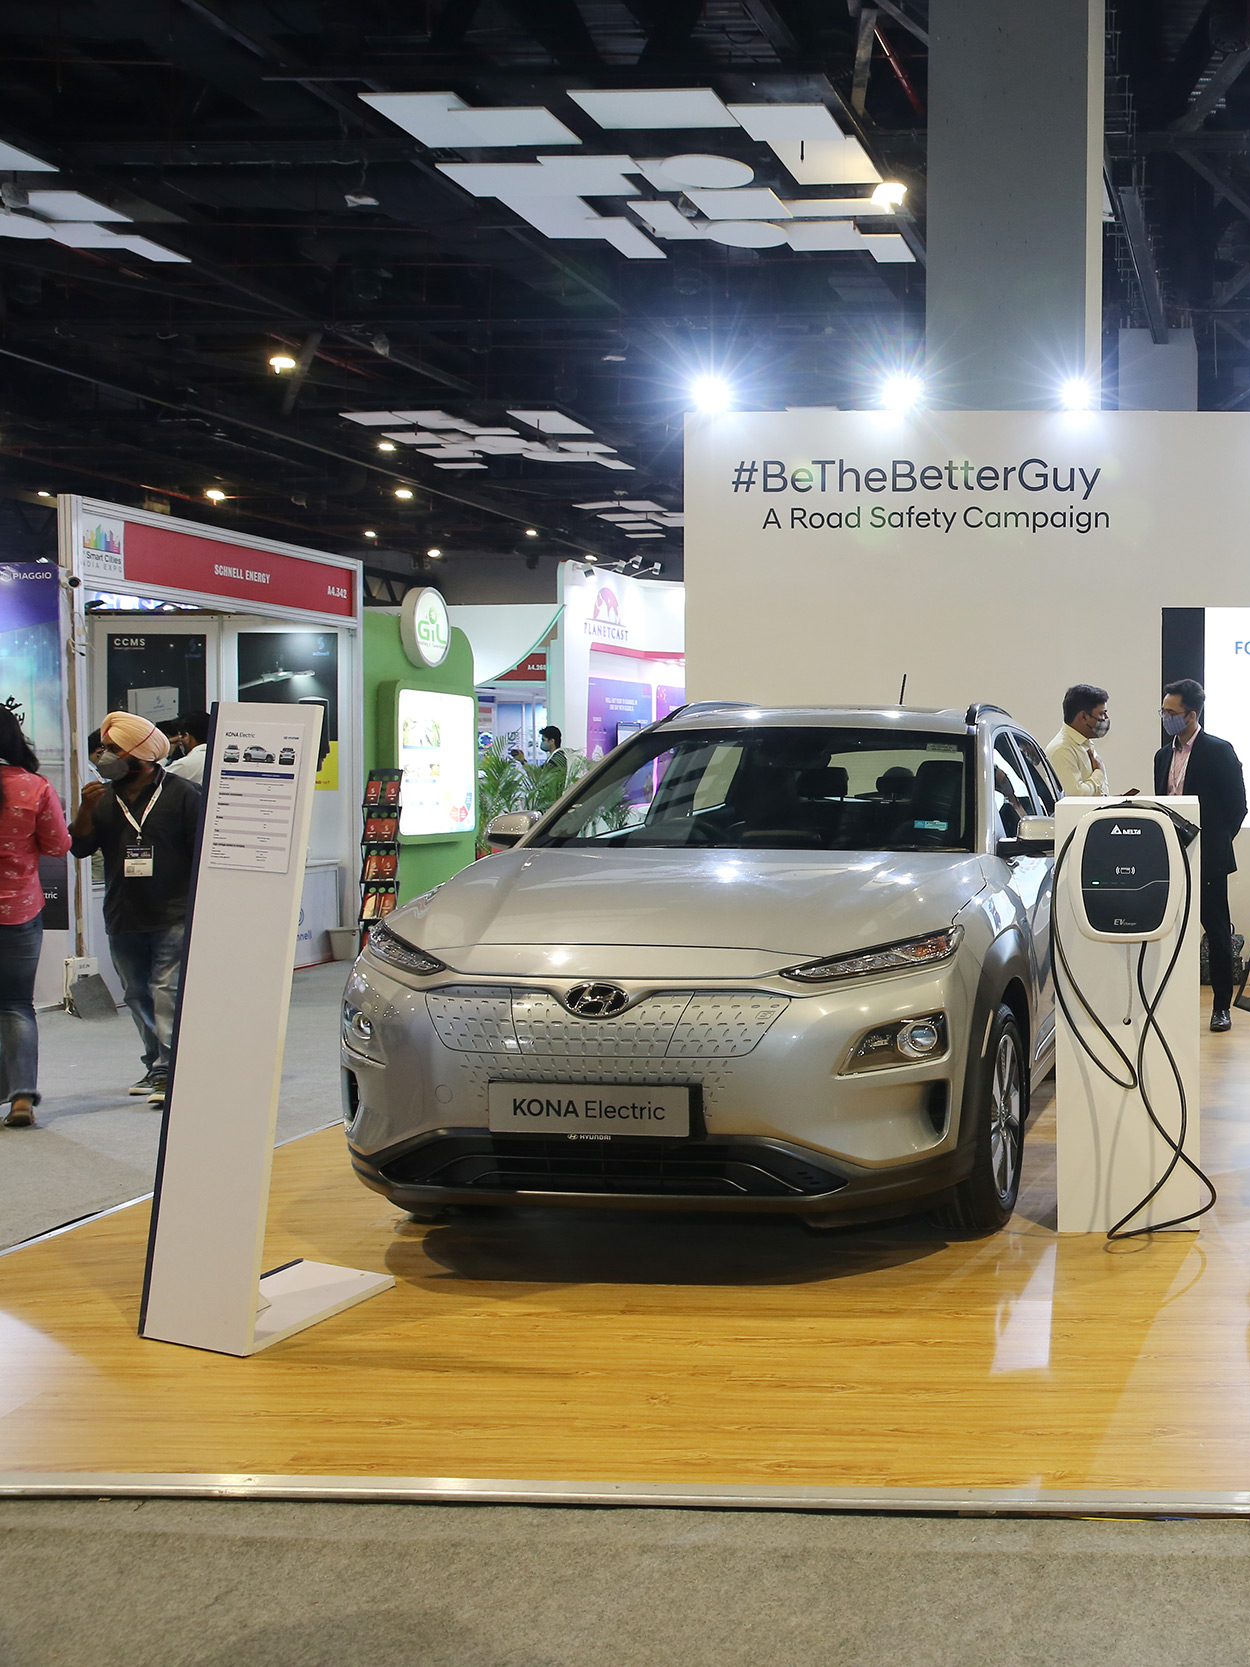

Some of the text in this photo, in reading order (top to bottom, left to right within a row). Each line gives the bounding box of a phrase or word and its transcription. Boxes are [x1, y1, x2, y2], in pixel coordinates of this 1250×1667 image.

[731, 458, 1102, 499] #BeTheBetterGuy
[762, 506, 1111, 533] A Road Safety Campaign
[13, 572, 52, 580] PIAGGIO
[214, 564, 271, 584] SCHNELL ENERGY
[327, 585, 347, 599] A4.342
[584, 622, 628, 641] PLANETCAST
[114, 637, 146, 646] CCMS
[1113, 918, 1125, 926] EV
[512, 1098, 666, 1121] KONA Electric
